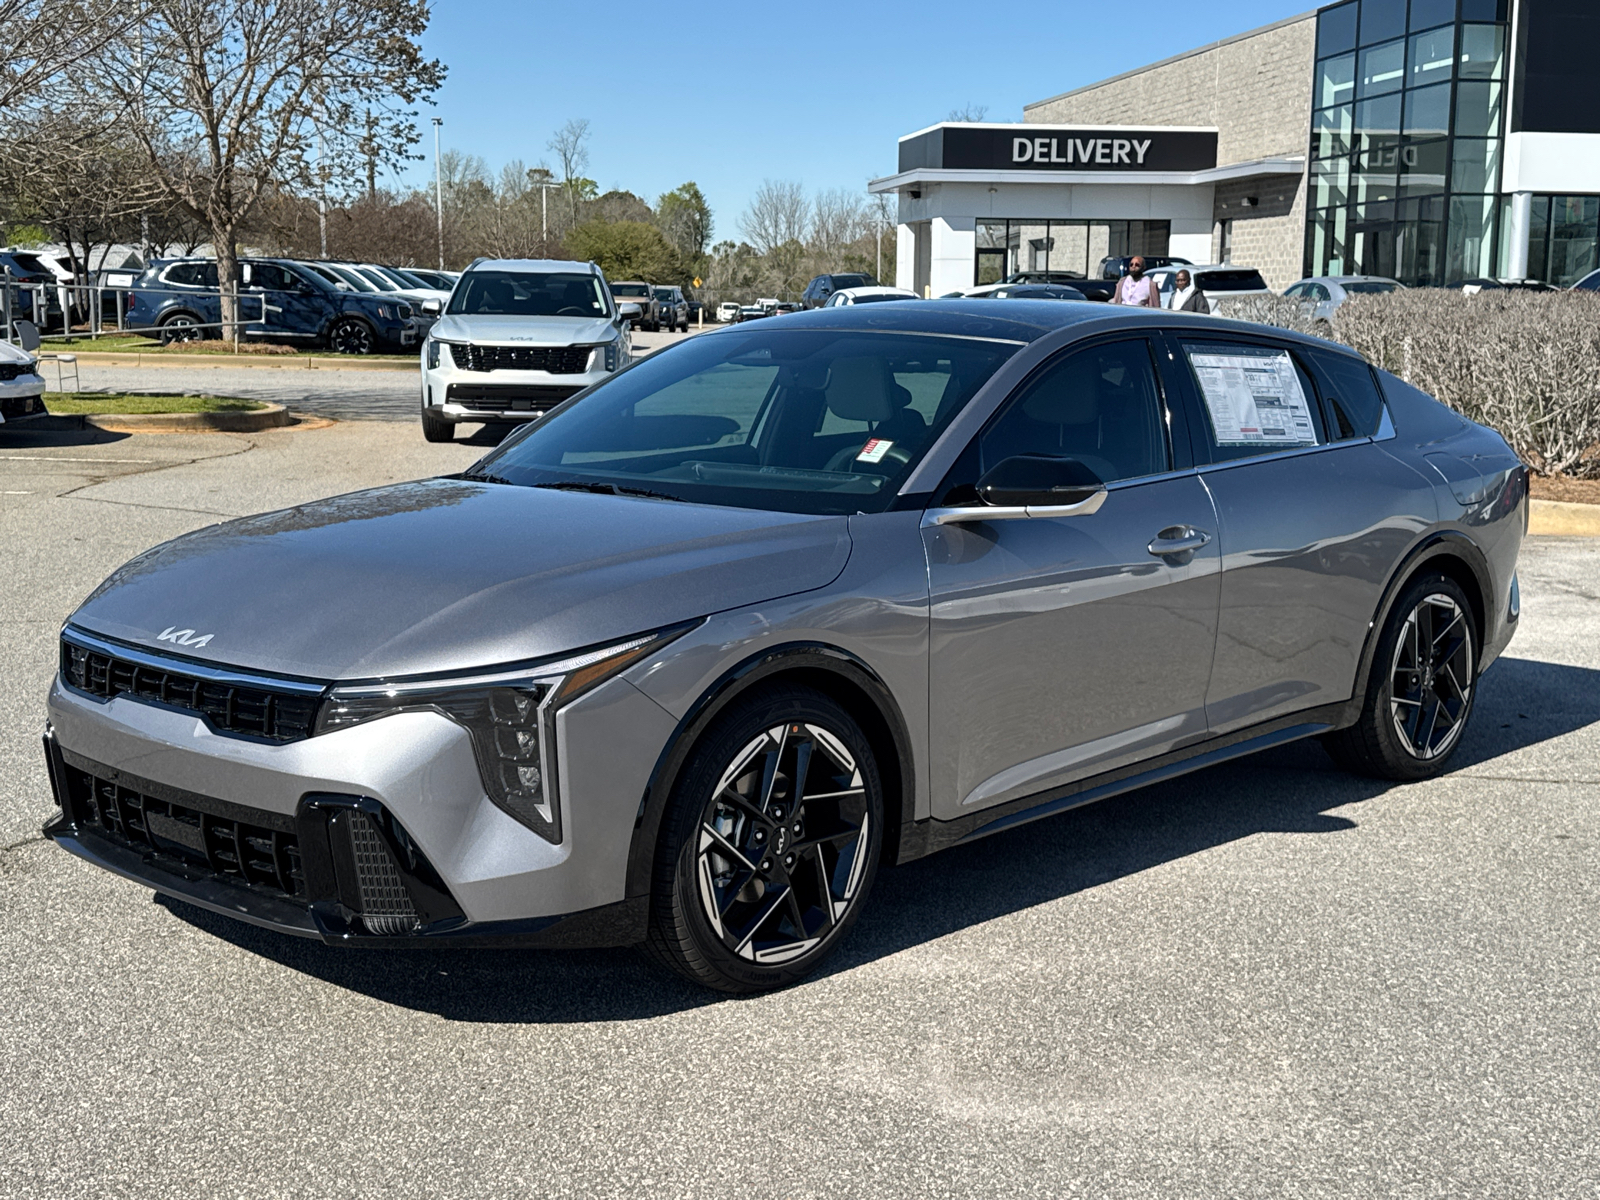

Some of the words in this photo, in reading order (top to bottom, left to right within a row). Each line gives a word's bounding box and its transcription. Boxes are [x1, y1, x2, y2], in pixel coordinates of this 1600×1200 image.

[1012, 137, 1152, 164] DELIVERY
[156, 625, 215, 649] KIA
[859, 744, 881, 810] KUMHO
